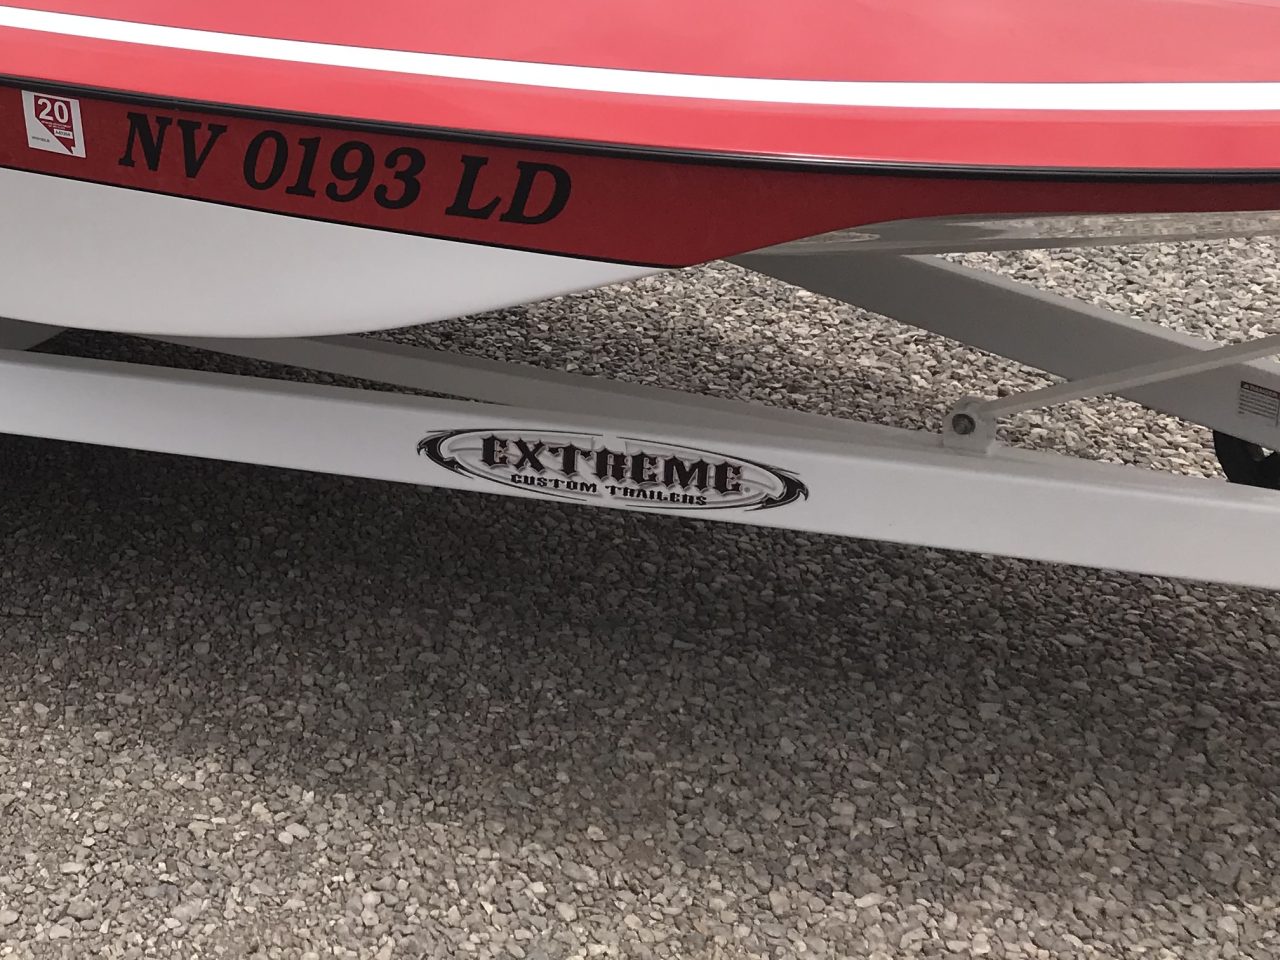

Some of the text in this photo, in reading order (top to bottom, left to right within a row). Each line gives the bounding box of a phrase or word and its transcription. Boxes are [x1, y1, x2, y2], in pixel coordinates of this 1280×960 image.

[37, 98, 69, 123] 20
[118, 111, 572, 225] NV 0193 LD
[481, 434, 745, 497] EXTREME
[510, 474, 707, 506] CUSTOM TRAILERS
